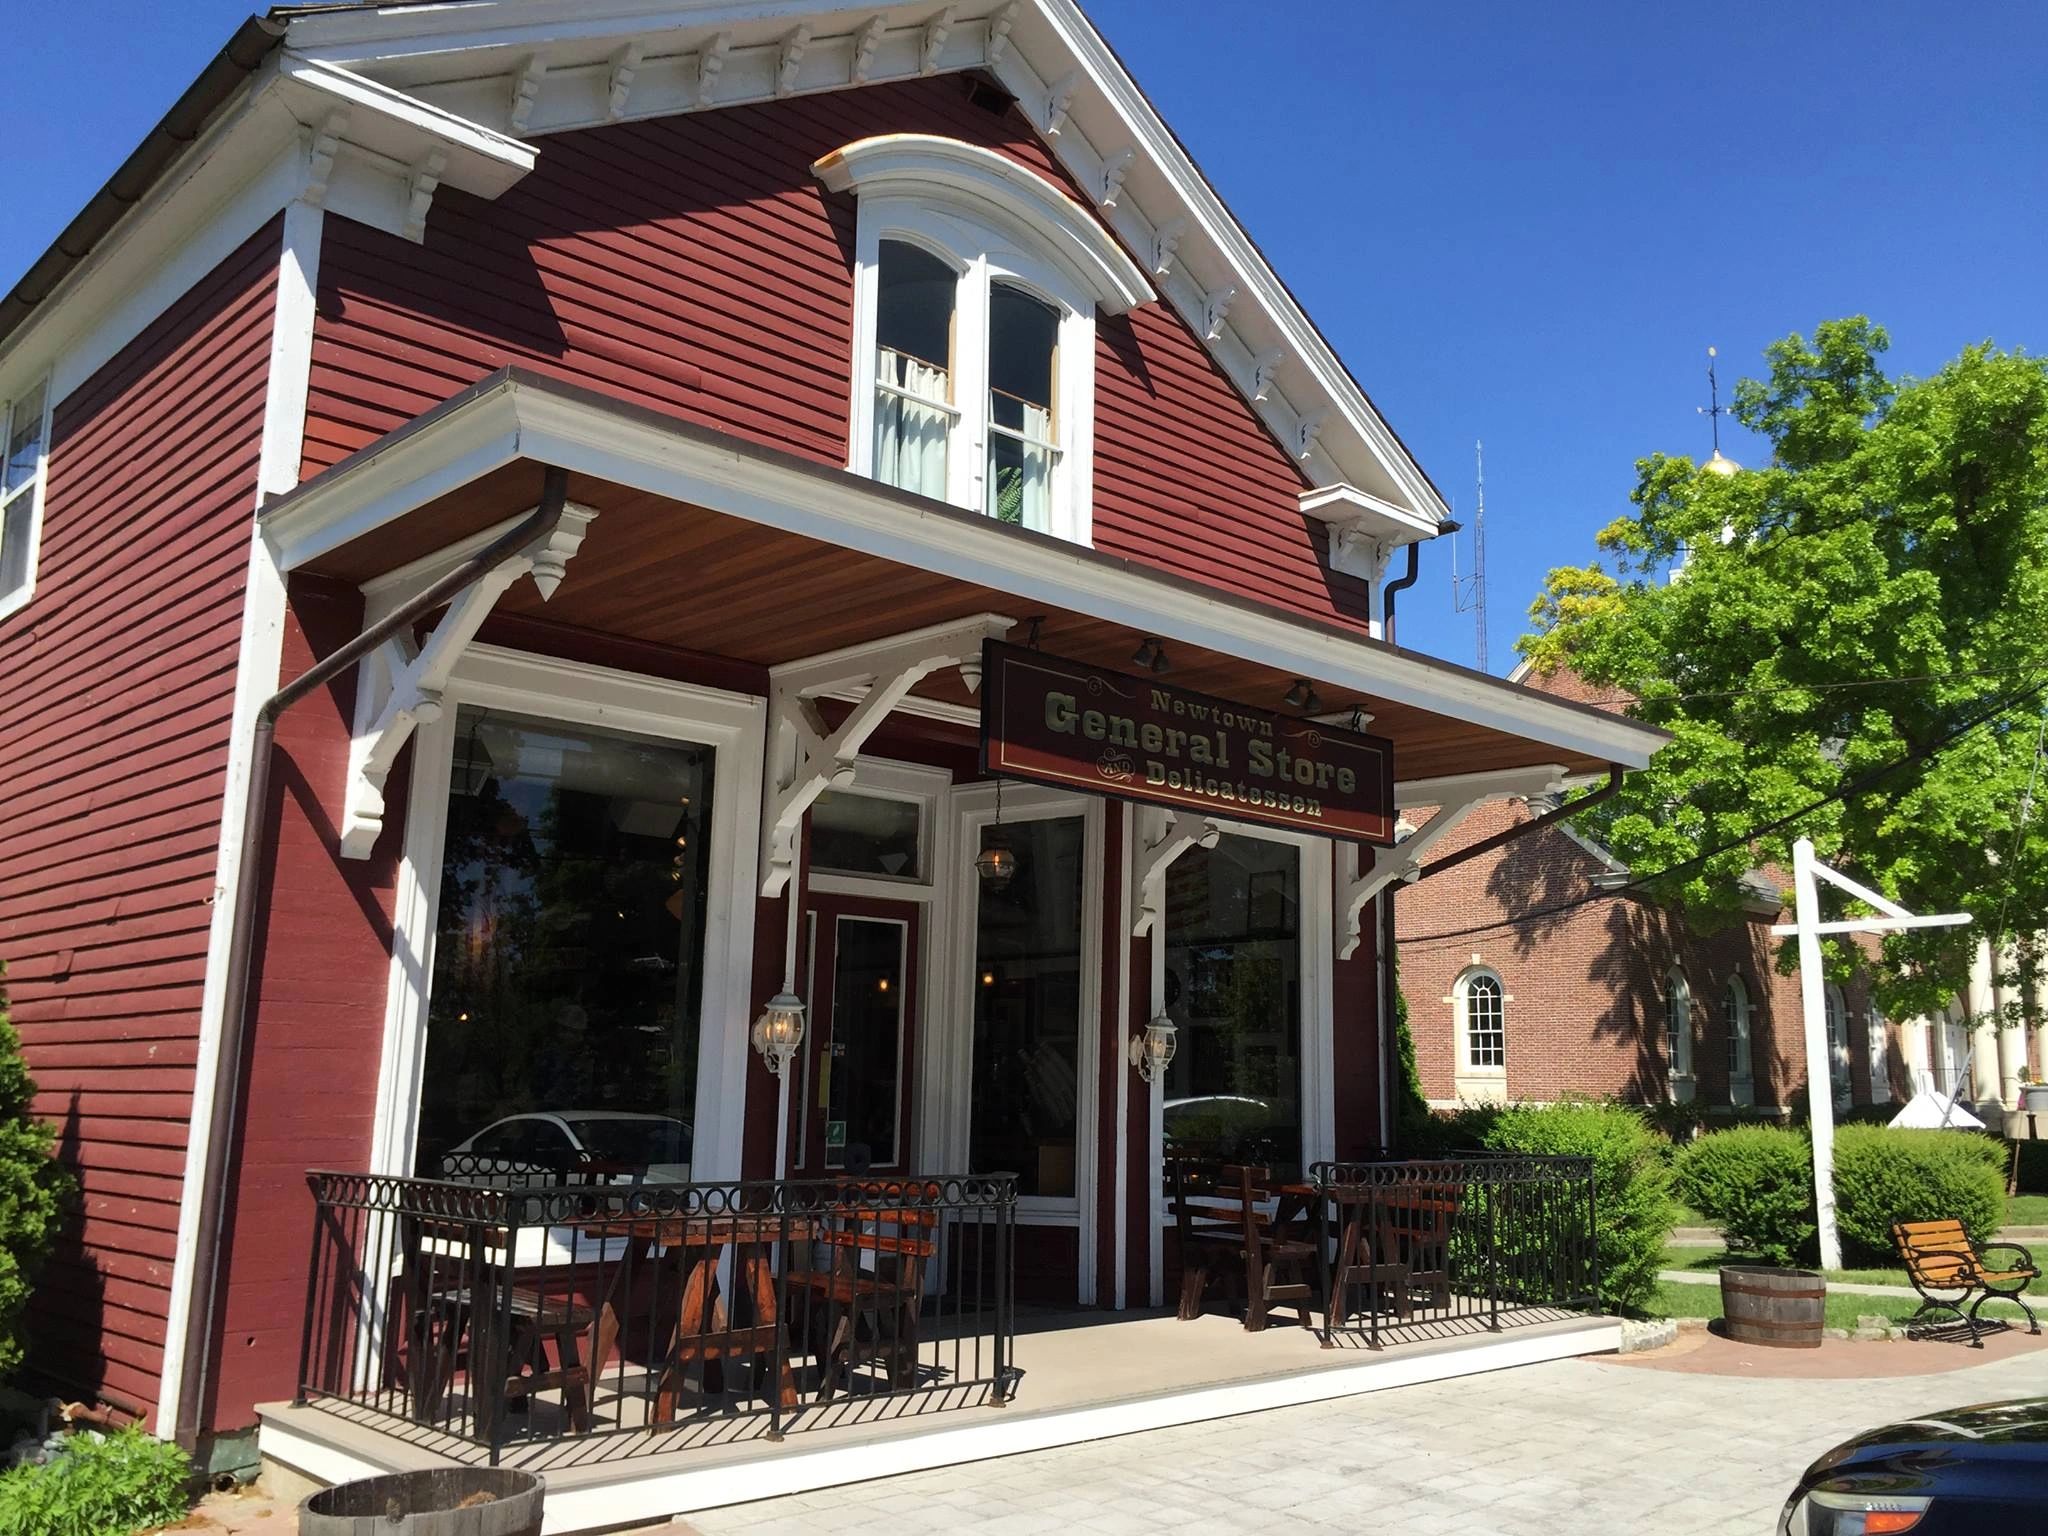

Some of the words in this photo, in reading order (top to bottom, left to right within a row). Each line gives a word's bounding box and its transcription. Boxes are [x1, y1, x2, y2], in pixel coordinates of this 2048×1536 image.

[1045, 691, 1230, 769] General
[1247, 738, 1357, 794] Store
[1150, 691, 1275, 737] Newtown
[1104, 761, 1130, 774] AND
[1146, 760, 1323, 817] Delicatessen
